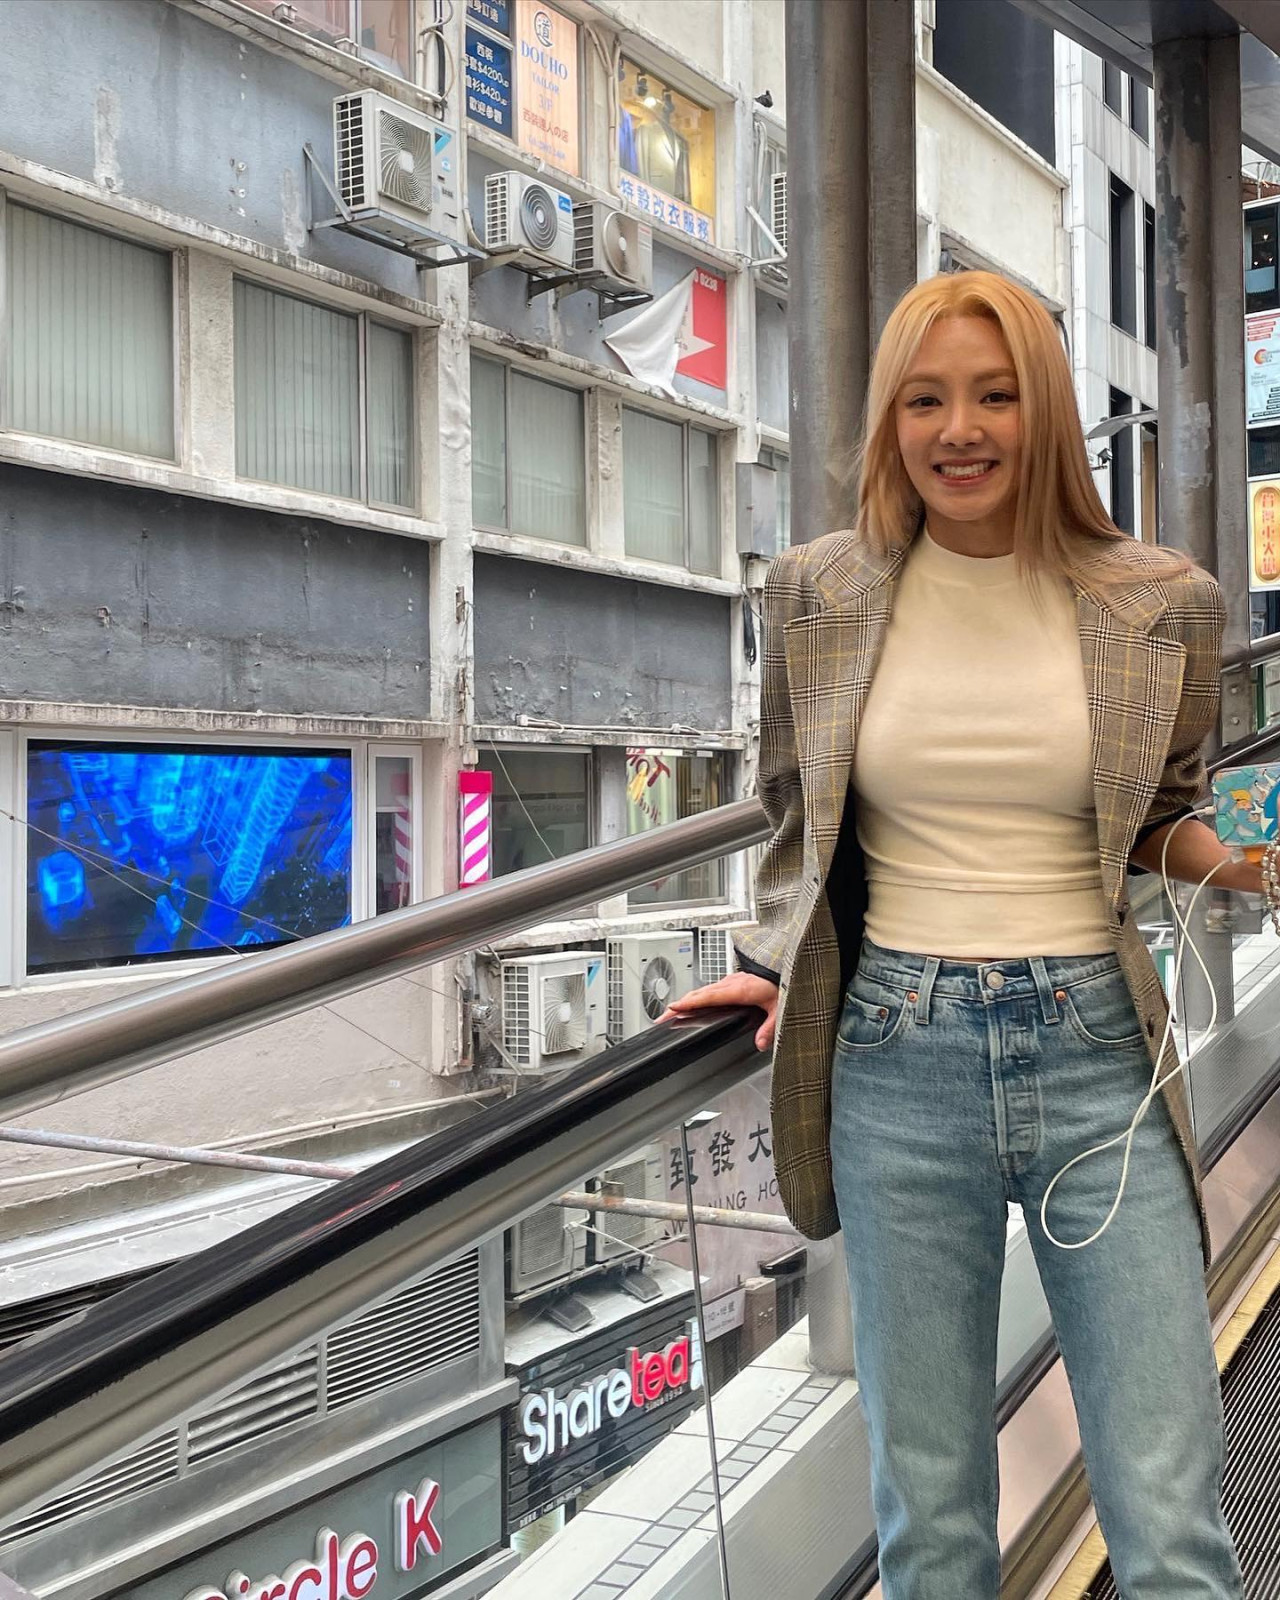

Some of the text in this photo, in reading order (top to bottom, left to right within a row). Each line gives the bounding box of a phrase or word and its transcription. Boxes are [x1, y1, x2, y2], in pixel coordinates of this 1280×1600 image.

[520, 40, 568, 80] DOUHO
[531, 71, 560, 96] TAILOR
[517, 1335, 689, 1464] Sharetea
[394, 1477, 442, 1572] K
